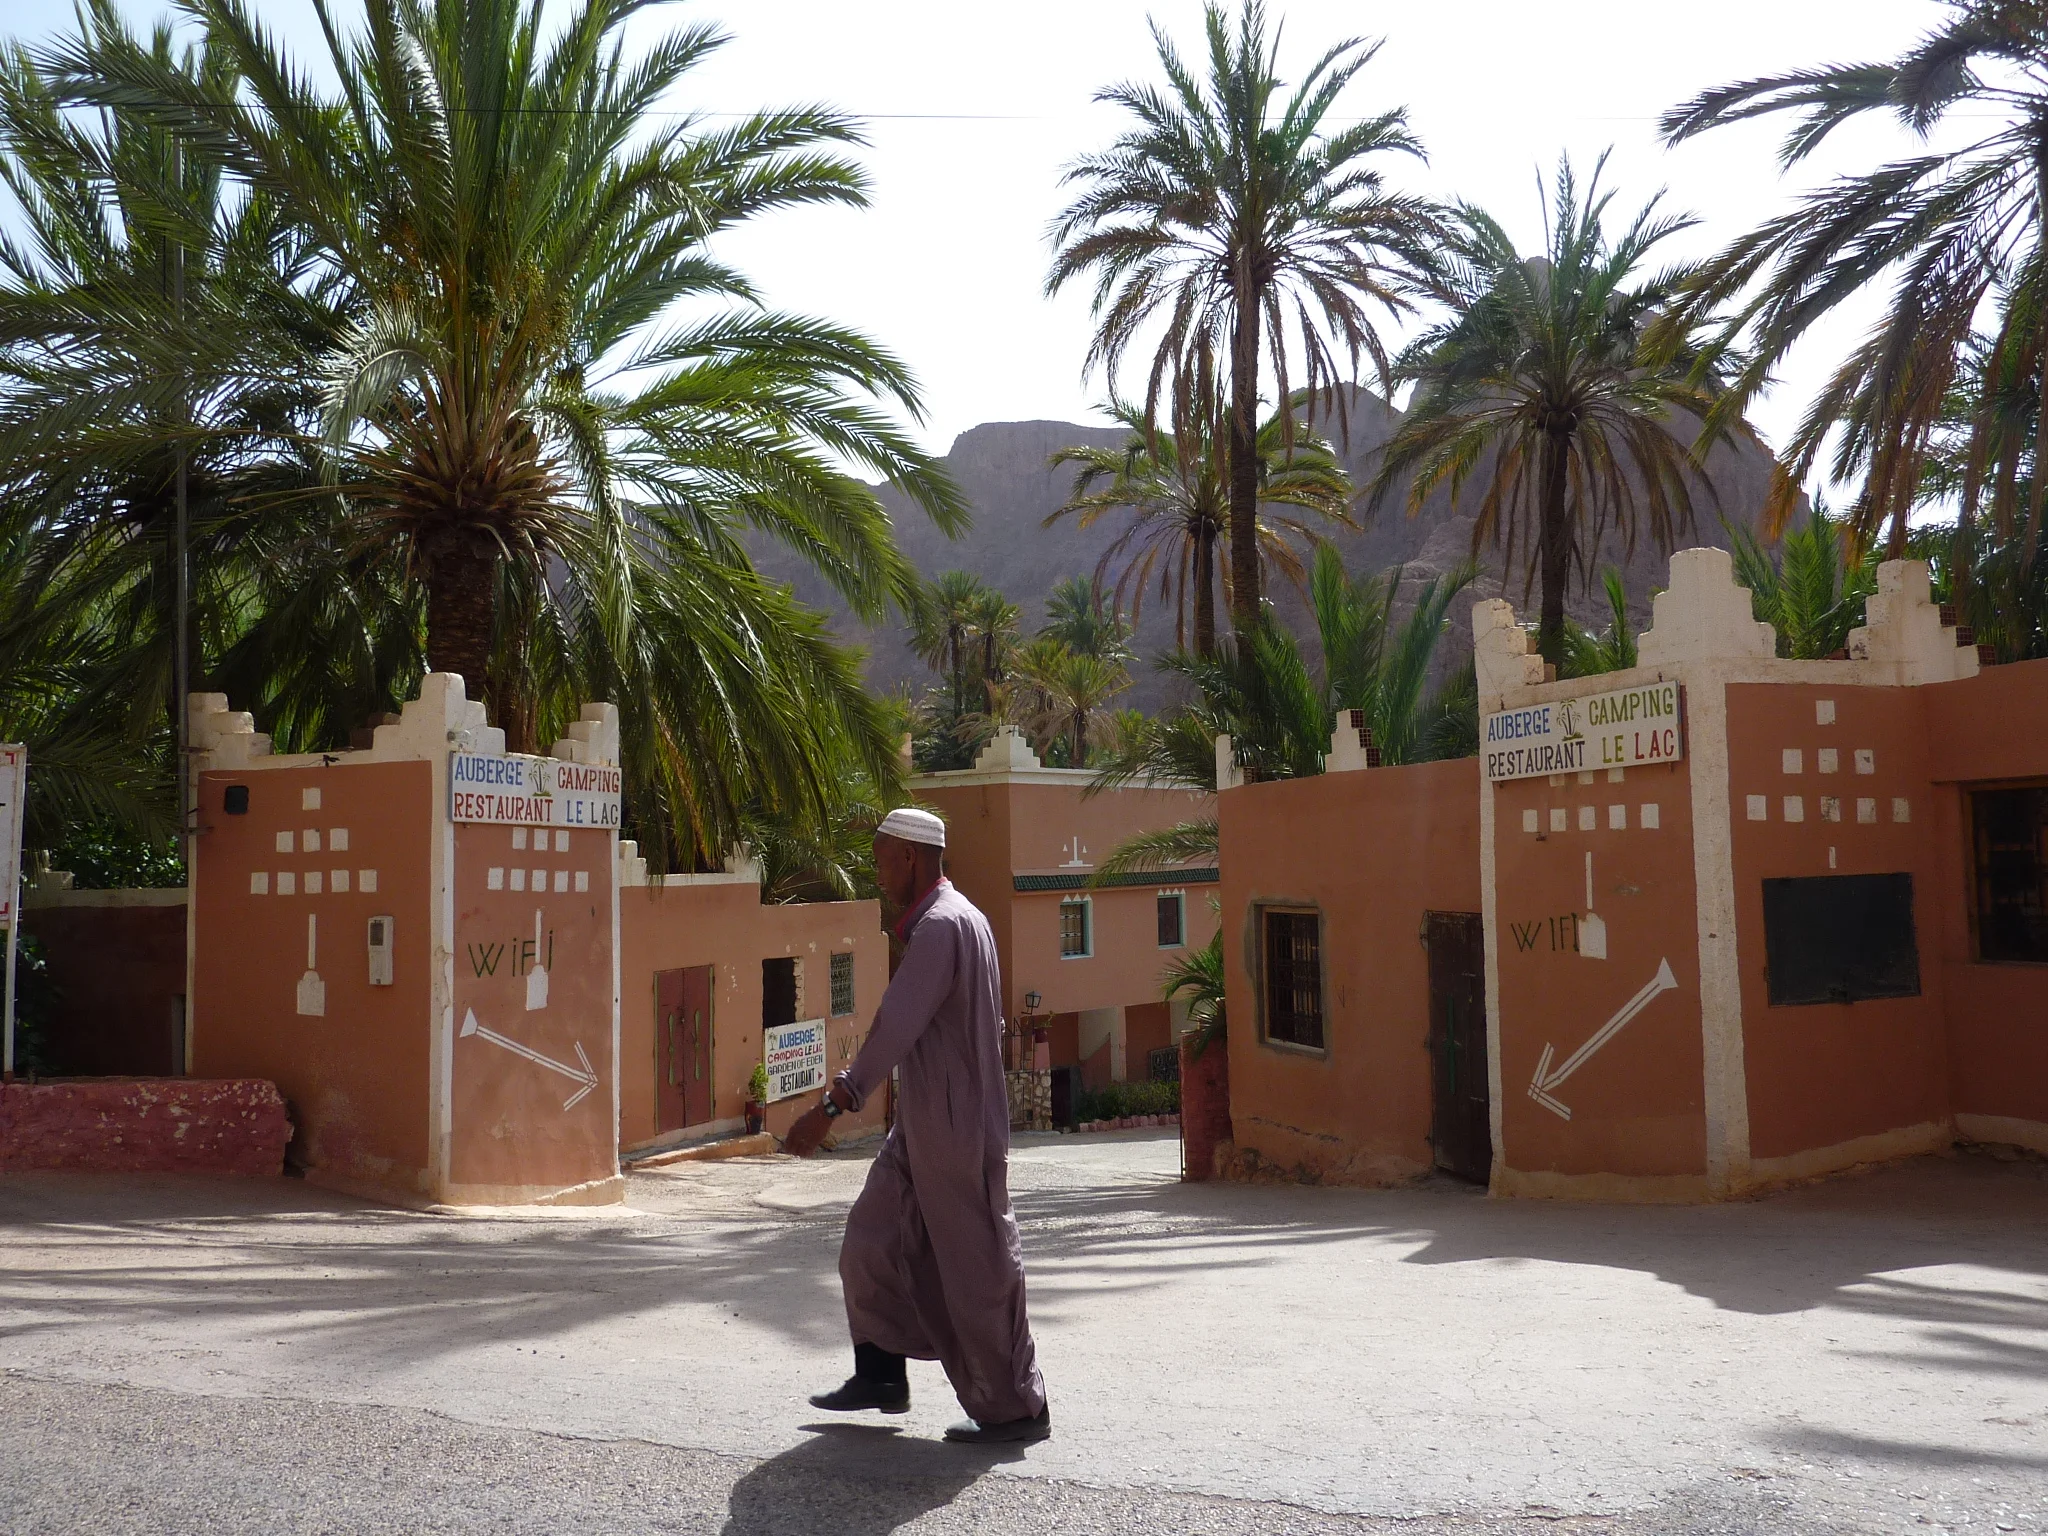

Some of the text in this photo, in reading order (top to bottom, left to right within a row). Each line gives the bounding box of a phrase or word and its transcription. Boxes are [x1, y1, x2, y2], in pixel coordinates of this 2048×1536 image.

[1488, 687, 1673, 742] AUBERGE CAMPING
[1488, 729, 1675, 777] RESTAURANT LE LAC
[455, 756, 620, 793] AUBERGE CAMPING
[454, 793, 618, 825] RESTAURANT LE LAC
[779, 1028, 815, 1049] AUBERGE
[767, 1048, 803, 1064] CAMPING
[804, 1045, 812, 1056] LE
[767, 1054, 823, 1076] GARDEN OF EDEN
[780, 1068, 815, 1093] RESTAURANT
